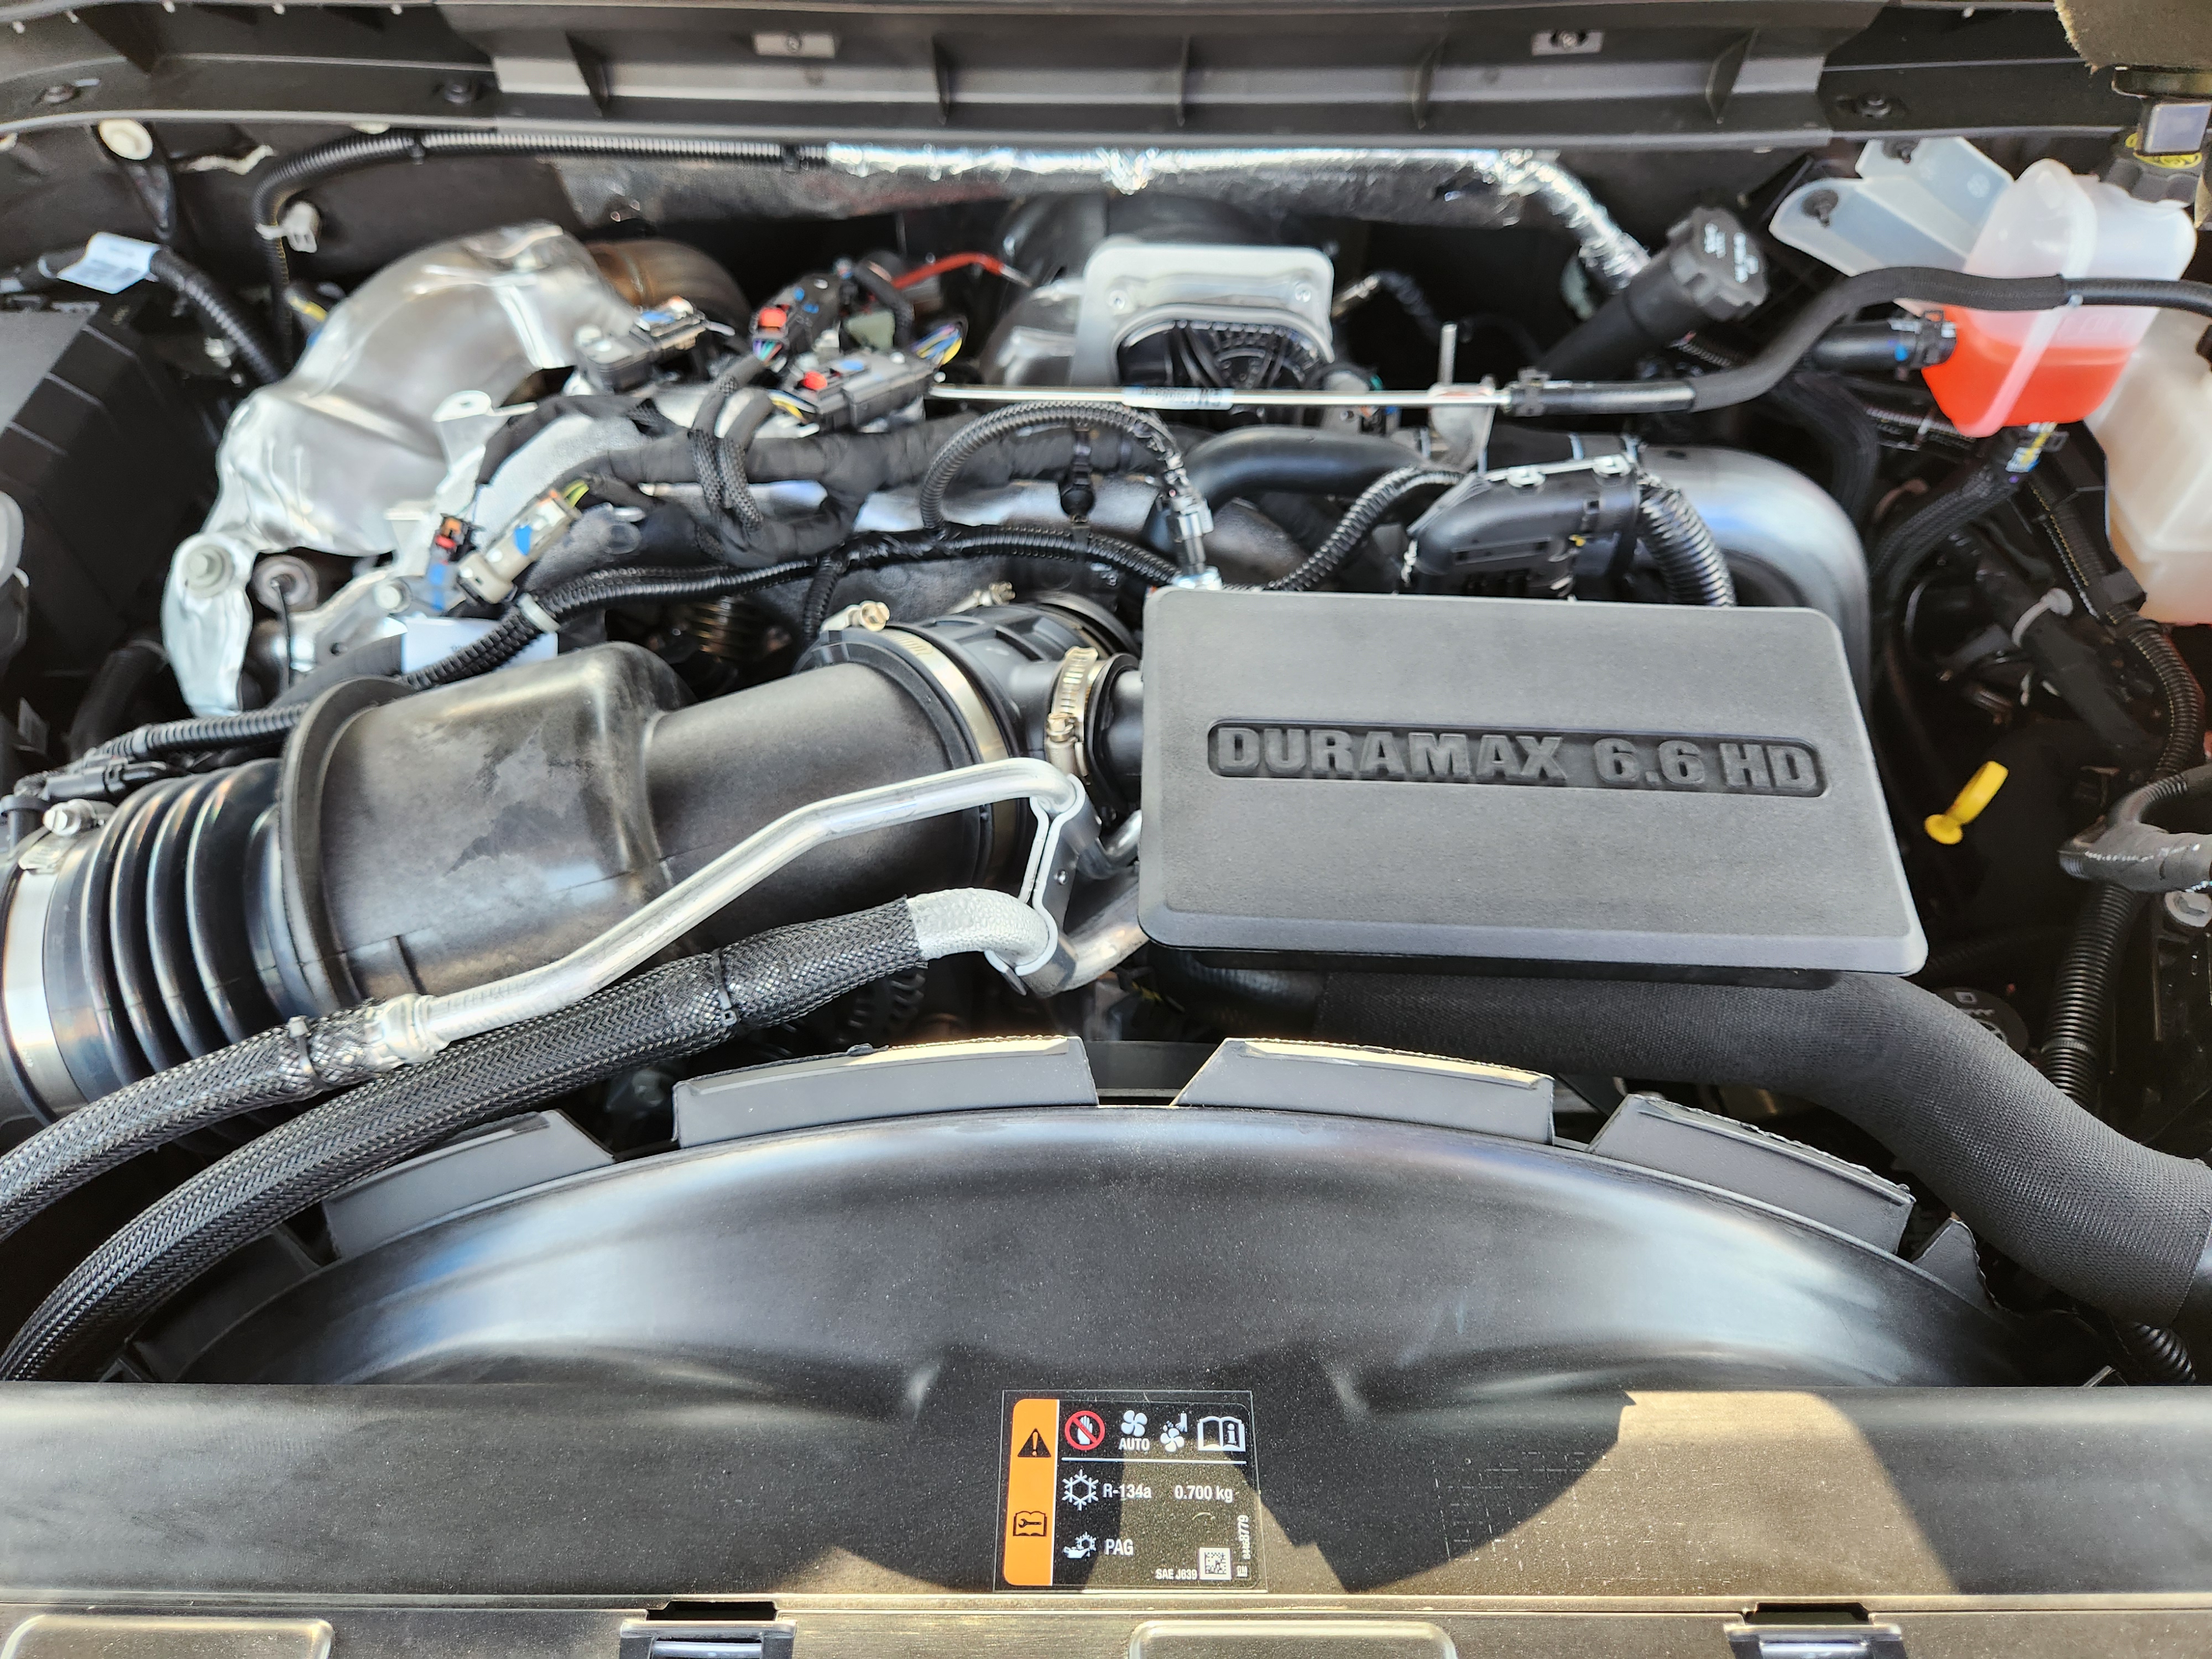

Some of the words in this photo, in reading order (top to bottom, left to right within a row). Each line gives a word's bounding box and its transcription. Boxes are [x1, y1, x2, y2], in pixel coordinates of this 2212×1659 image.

[1217, 727, 1568, 780] DURAMAX
[1593, 738, 1705, 785] 6.6
[1719, 743, 1818, 791] HD
[1118, 1438, 1150, 1451] AUTO
[1102, 1483, 1152, 1499] R-134a
[1175, 1485, 1213, 1500] 0.700
[1216, 1485, 1233, 1503] kg
[1105, 1539, 1134, 1556] PAG
[1155, 1568, 1174, 1580] SAE
[1176, 1568, 1197, 1580] J639
